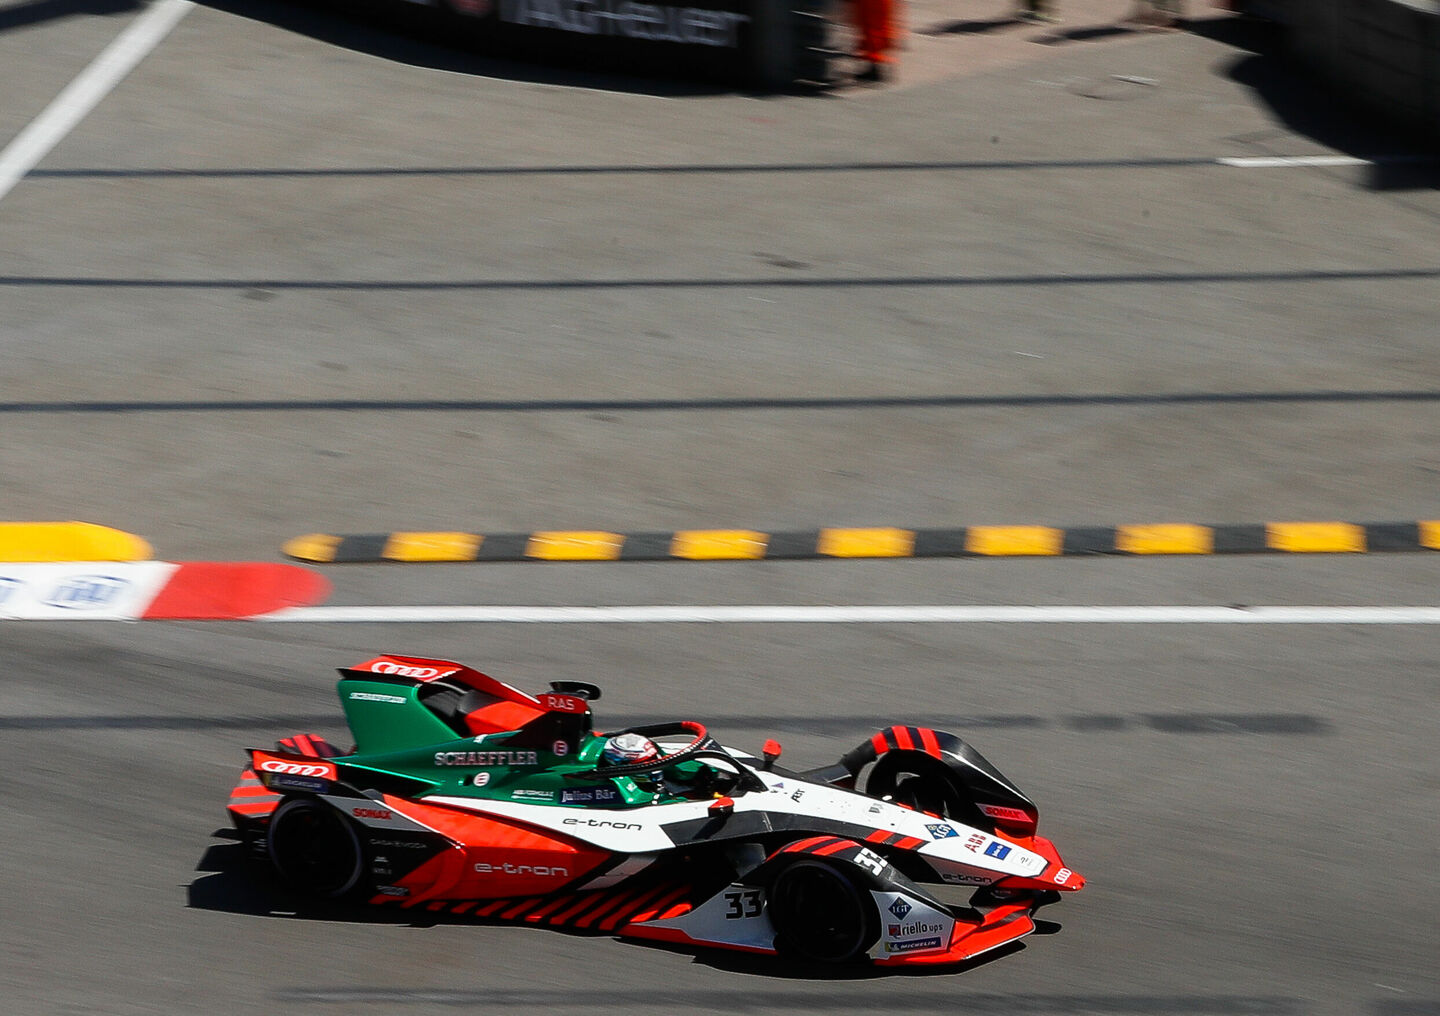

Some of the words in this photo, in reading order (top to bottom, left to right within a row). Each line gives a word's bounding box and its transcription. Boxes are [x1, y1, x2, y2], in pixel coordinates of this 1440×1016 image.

[547, 696, 575, 711] RAS
[434, 750, 538, 766] SCHAEFFLER
[562, 790, 593, 802] Julius
[595, 789, 616, 800] Bär
[562, 818, 643, 831] e-tron
[964, 833, 988, 854] ABB
[474, 862, 568, 877] e-tron
[942, 873, 993, 884] e-tron
[724, 892, 762, 920] 33
[902, 921, 928, 936] riello
[929, 924, 944, 933] ups
